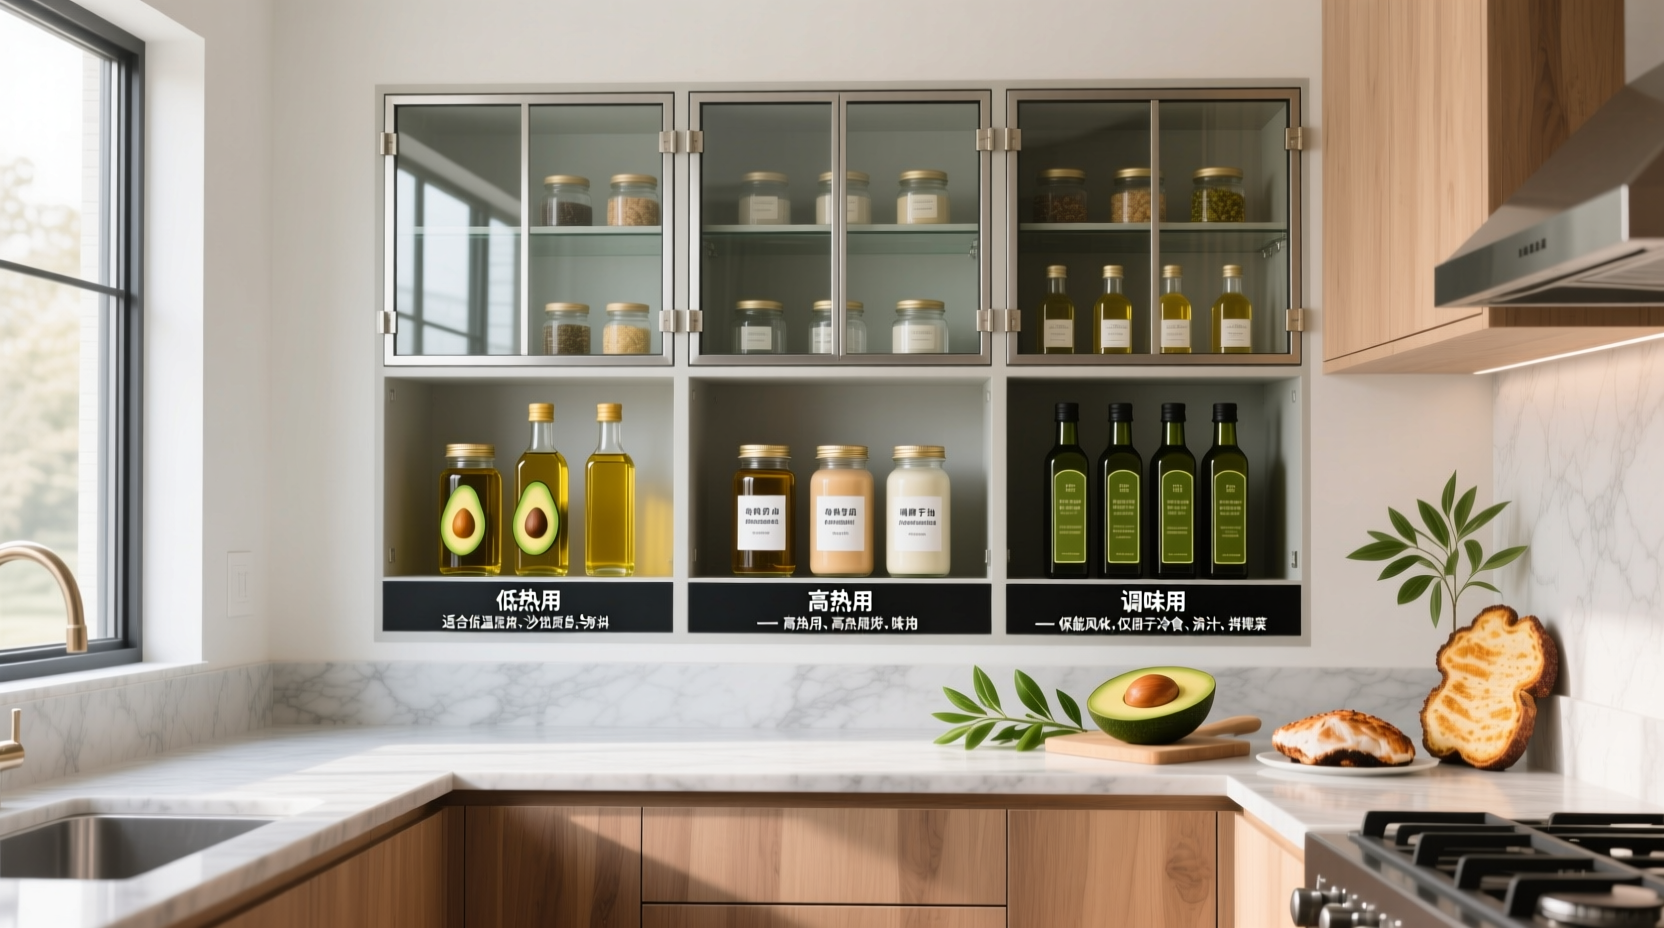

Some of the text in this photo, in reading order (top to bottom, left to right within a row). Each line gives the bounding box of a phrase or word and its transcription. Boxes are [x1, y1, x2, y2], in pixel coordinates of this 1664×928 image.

[496, 589, 561, 613] 低热用
[808, 589, 873, 613] 高热用
[1121, 590, 1186, 613] 调味用
